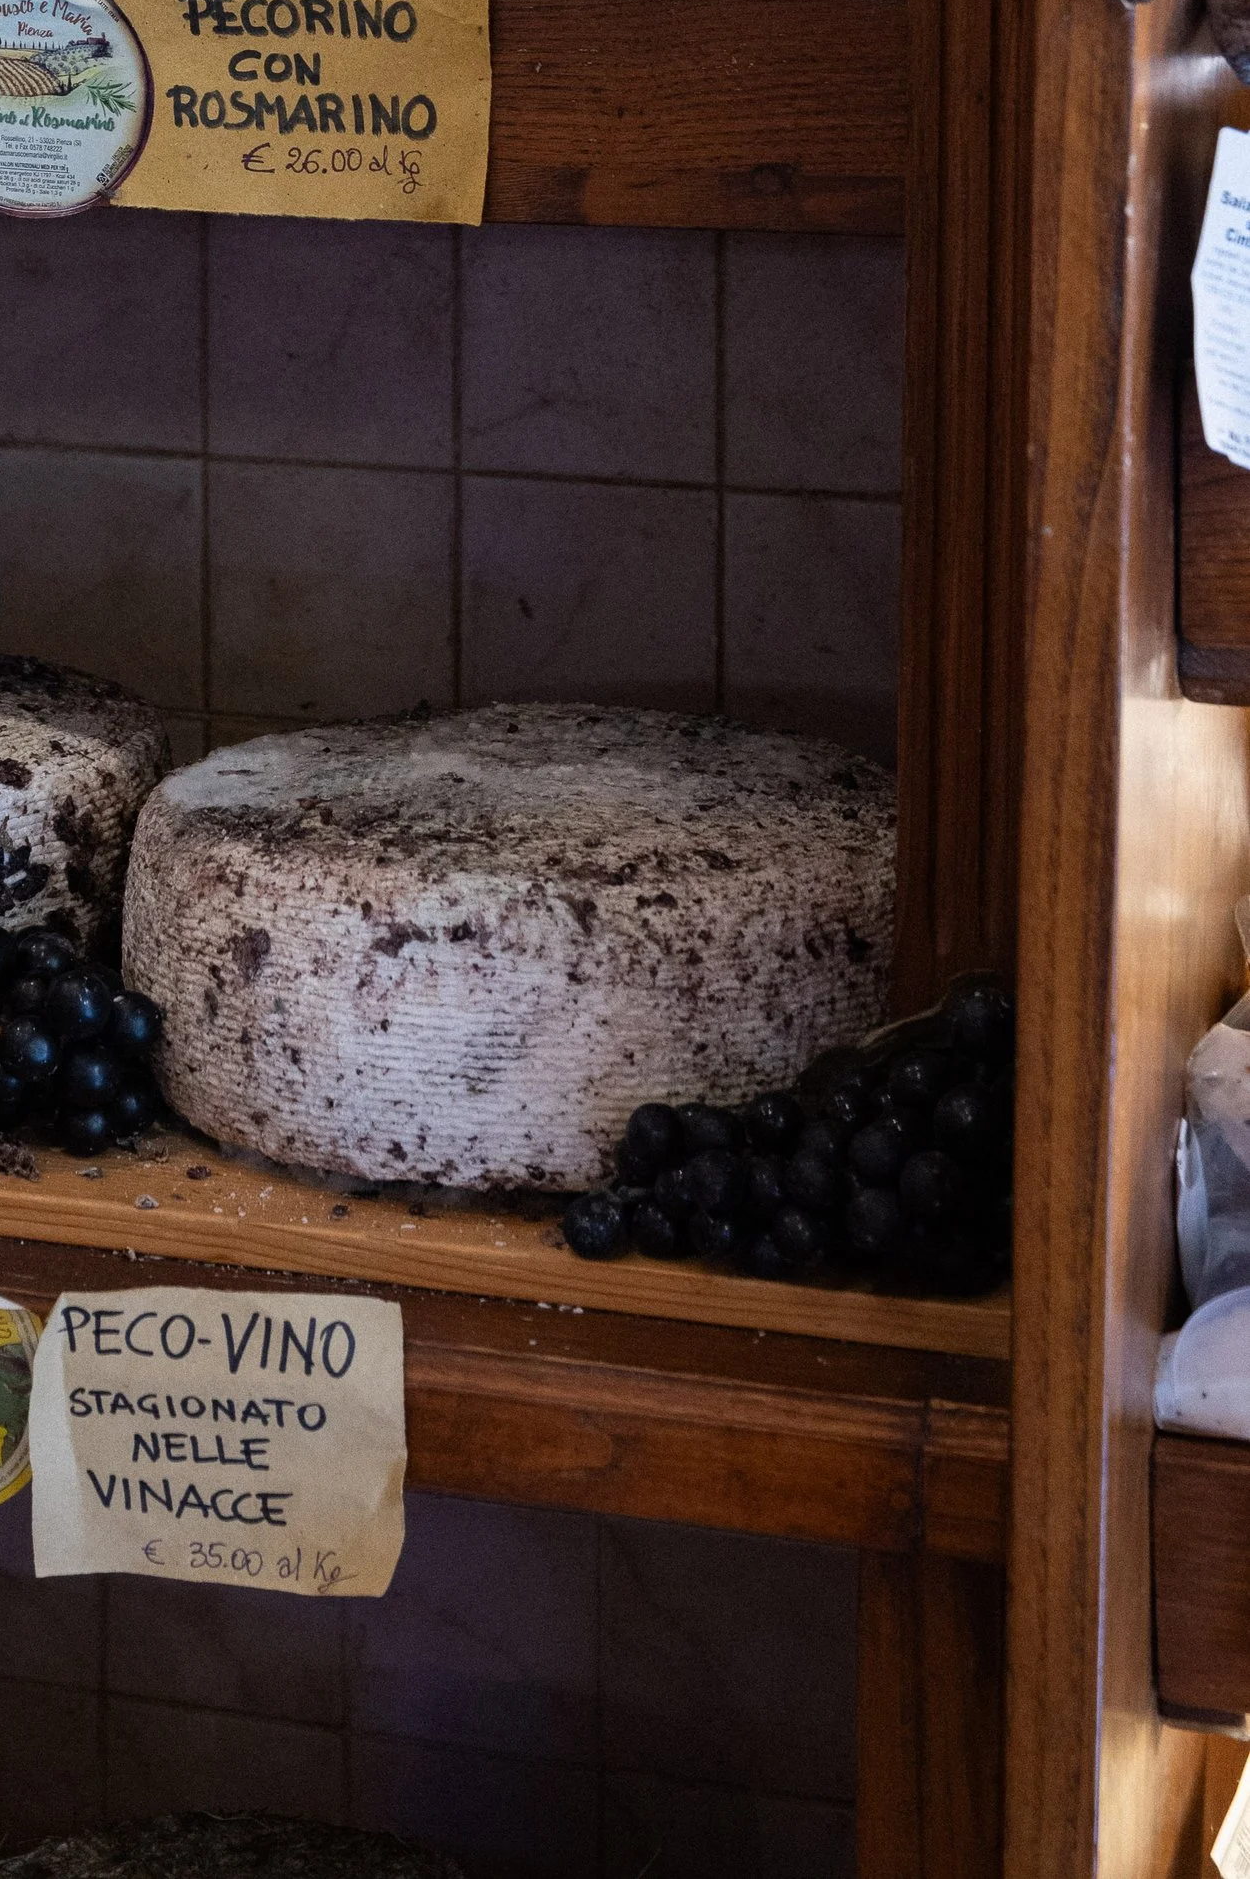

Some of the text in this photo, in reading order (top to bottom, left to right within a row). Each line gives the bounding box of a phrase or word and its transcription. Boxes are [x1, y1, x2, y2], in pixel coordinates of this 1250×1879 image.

[39, 0, 48, 14] e
[17, 21, 54, 38] Pienza
[228, 49, 322, 87] CON
[19, 114, 30, 126] al
[31, 105, 115, 132] Rosmarino
[165, 84, 438, 141] ROSMARINO
[29, 143, 43, 151] 0578
[56, 138, 73, 146] Pienza
[241, 142, 275, 174] €
[285, 146, 363, 174] 26.00
[398, 149, 423, 195] Kg
[57, 1305, 356, 1378] PECO-VINO
[69, 1387, 327, 1432] STAGIONATO
[131, 1432, 270, 1470] NELLE
[86, 1469, 293, 1526] VINACCE
[142, 1539, 166, 1566] €
[189, 1540, 264, 1576] 35.00
